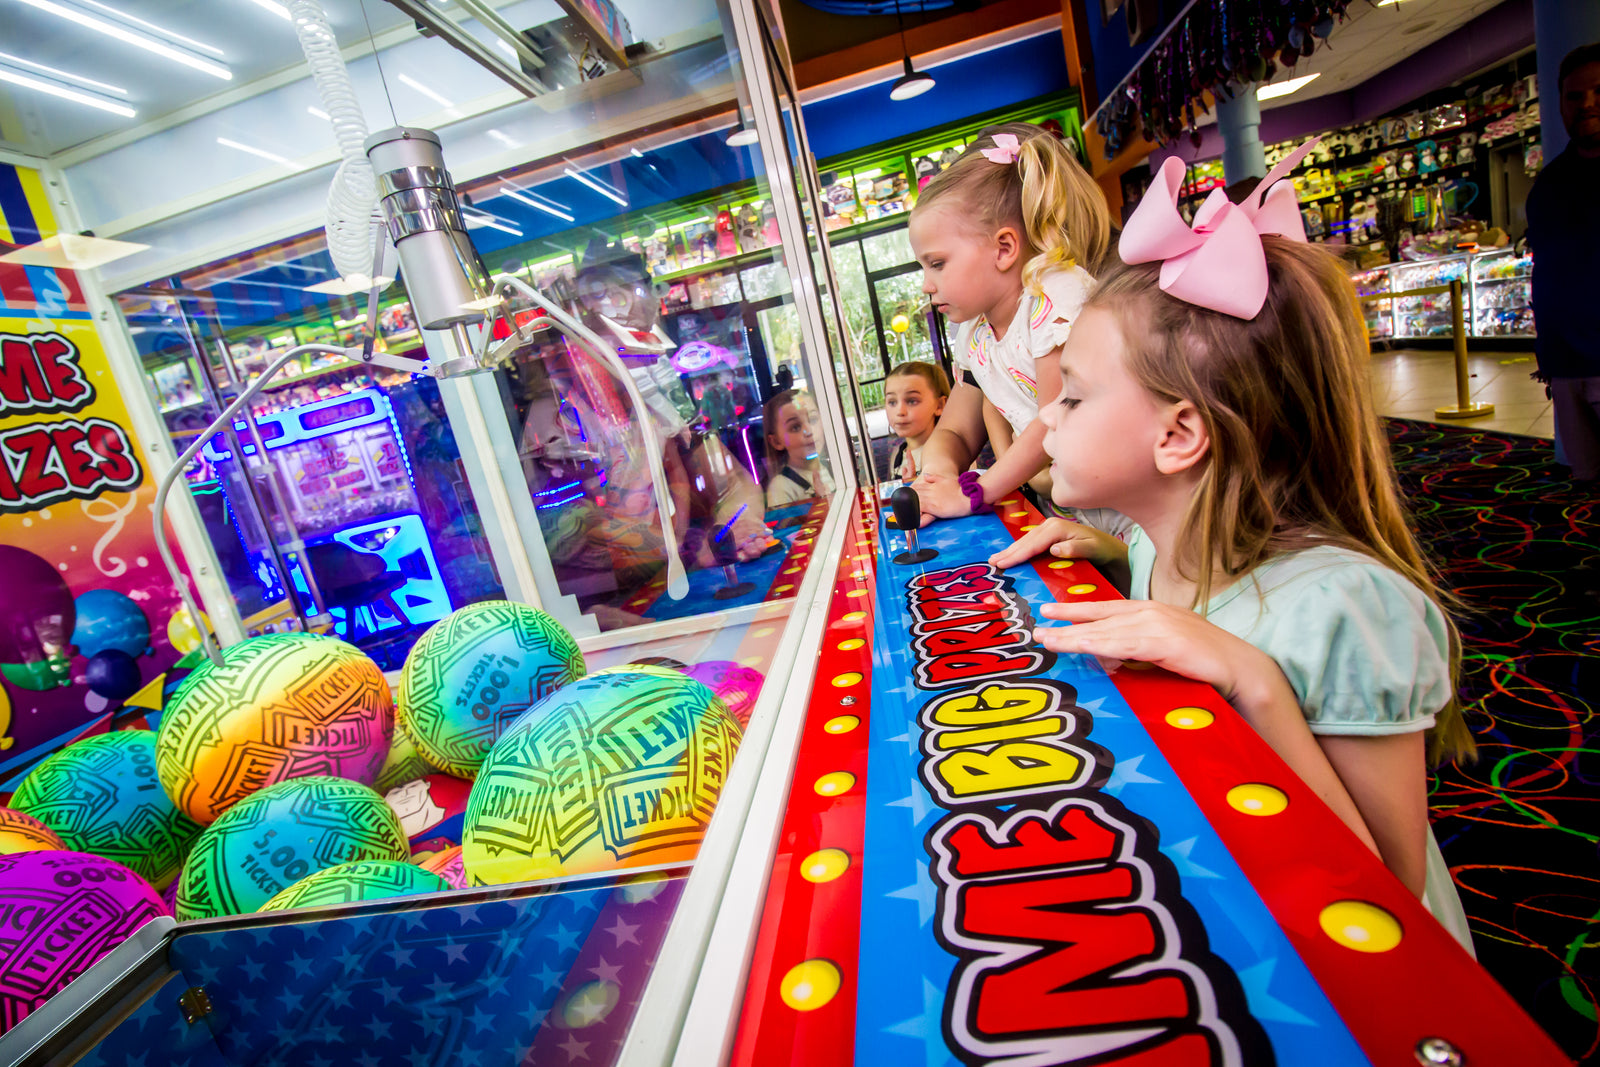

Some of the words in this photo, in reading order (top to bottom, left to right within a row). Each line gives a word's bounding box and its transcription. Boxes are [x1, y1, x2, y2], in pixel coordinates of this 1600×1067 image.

[453, 611, 492, 644] KET
[908, 563, 1043, 688] PRIZES
[307, 667, 357, 709] TICKET
[455, 652, 496, 708] TICKETS
[472, 655, 520, 721] 1,000
[289, 725, 358, 747] TICKET
[628, 703, 689, 761] KET
[700, 719, 724, 801] TICKET
[924, 680, 1095, 804] BIG
[127, 743, 158, 792] 1,000
[544, 719, 587, 813] TICKET
[481, 784, 533, 826] TICKET
[622, 786, 693, 829] TICKET
[189, 857, 210, 904] KET
[253, 830, 309, 881] 5,00
[20, 902, 103, 974] TICKET
[931, 799, 1235, 1067] ME
